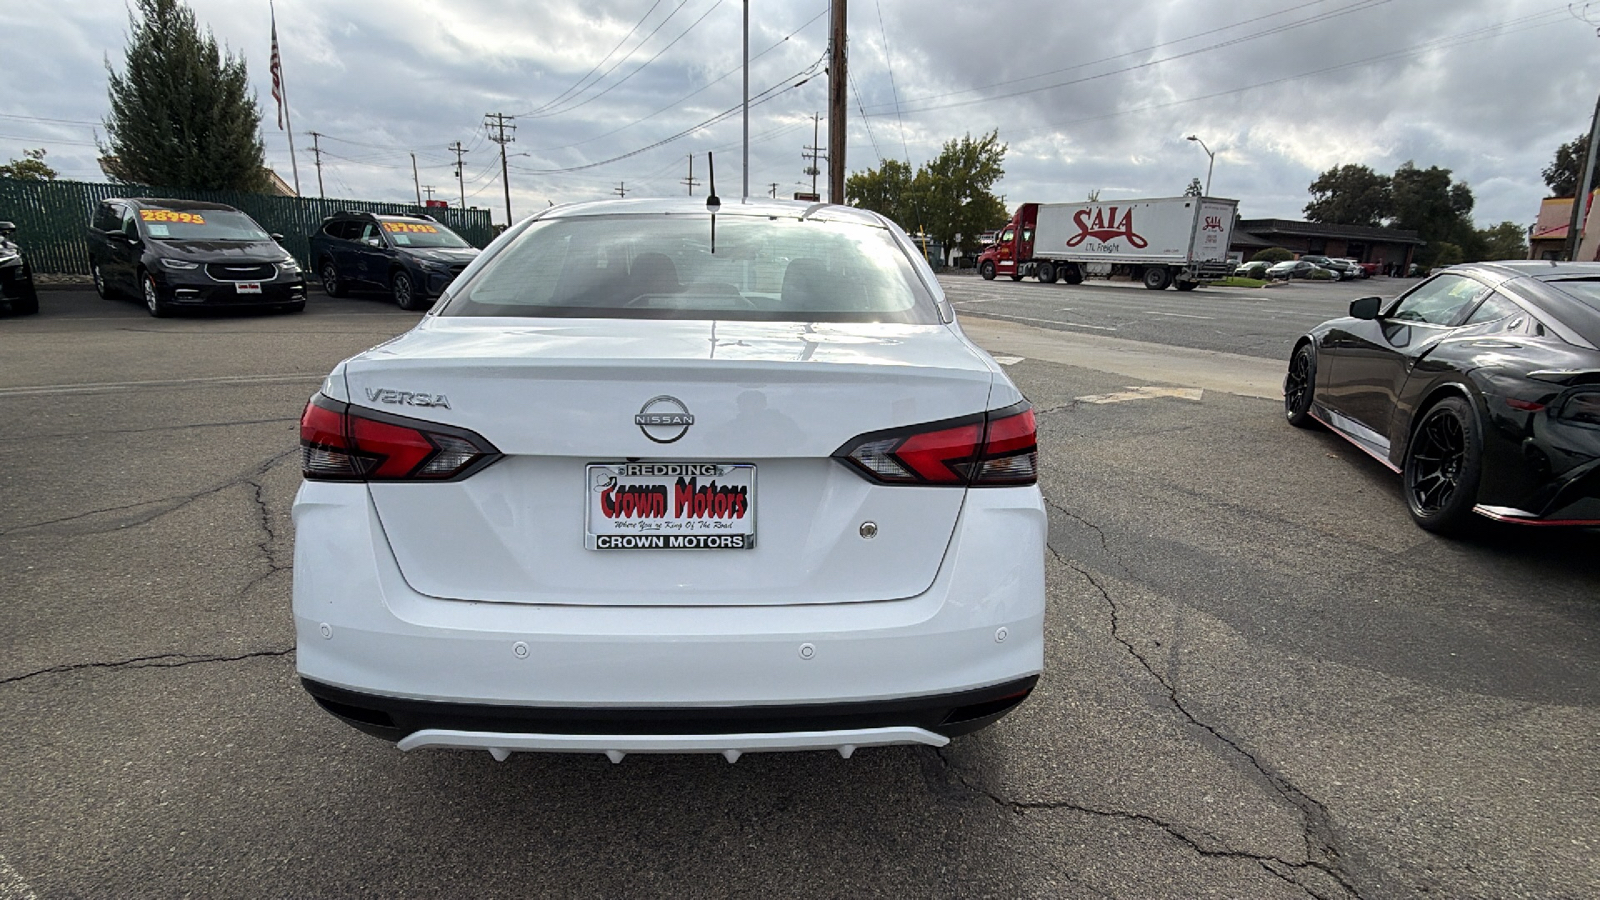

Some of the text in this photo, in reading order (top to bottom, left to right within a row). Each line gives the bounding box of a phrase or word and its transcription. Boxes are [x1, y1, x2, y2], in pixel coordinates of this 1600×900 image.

[142, 211, 205, 224] 28995
[1066, 207, 1148, 249] SAIA
[1085, 242, 1119, 253] LTL Freight
[365, 387, 452, 410] VERSA
[636, 416, 693, 424] NISSAN
[628, 465, 714, 476] REDDING
[601, 477, 748, 519] Crown Motors
[664, 521, 682, 530] King
[685, 521, 695, 530] Of
[713, 521, 734, 529] Road
[598, 537, 743, 548] CROWN MOTORS
